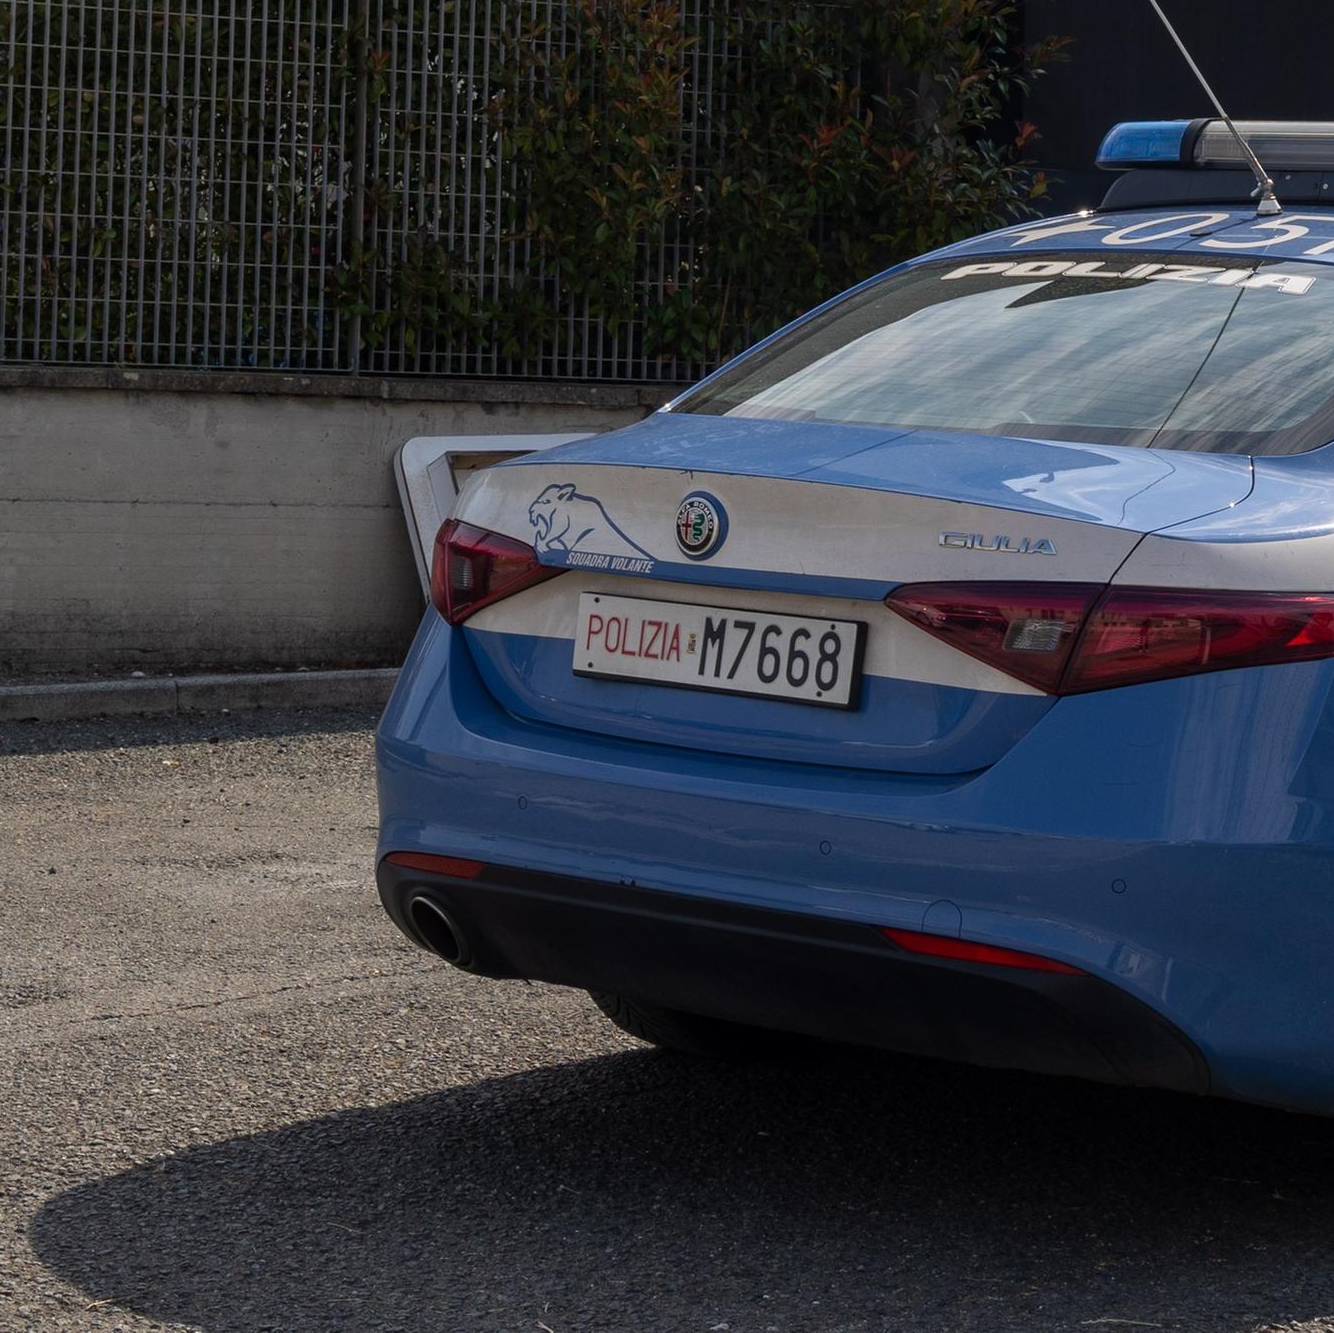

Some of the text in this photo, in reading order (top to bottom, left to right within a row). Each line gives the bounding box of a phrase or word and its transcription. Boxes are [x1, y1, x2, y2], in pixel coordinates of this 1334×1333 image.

[940, 261, 1319, 296] POLIZIA
[693, 501, 714, 529] ROMEO
[938, 531, 1057, 555] GIULIA
[566, 552, 655, 574] SQUADRA VOLANTE
[586, 614, 841, 692] POLIZIA M7668
